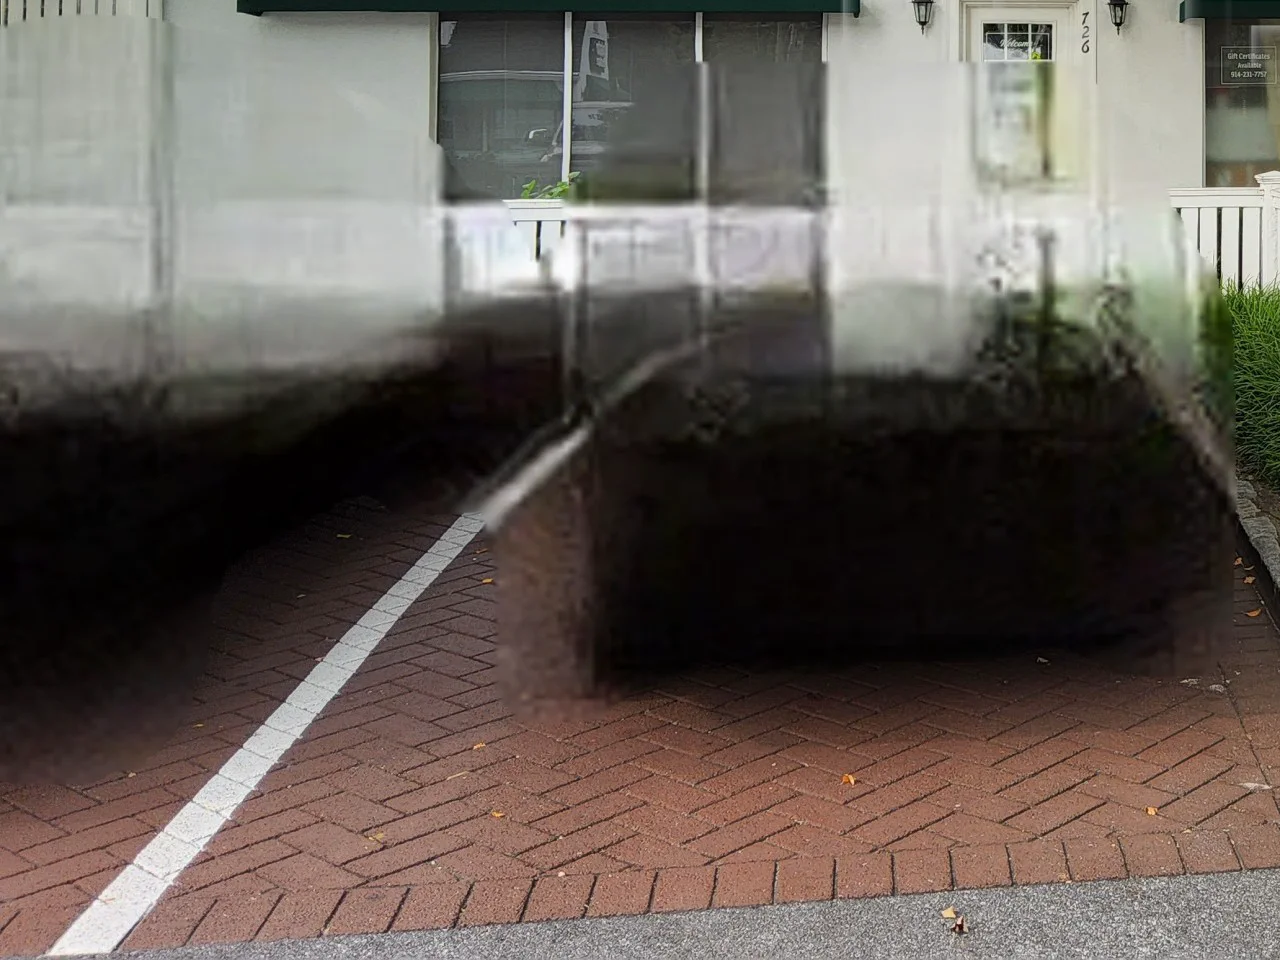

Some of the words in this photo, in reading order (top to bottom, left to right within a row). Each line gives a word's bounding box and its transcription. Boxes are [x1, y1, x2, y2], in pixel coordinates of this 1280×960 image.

[1081, 11, 1090, 54] 726
[1227, 52, 1238, 60] Gift
[1239, 52, 1271, 60] Certificates
